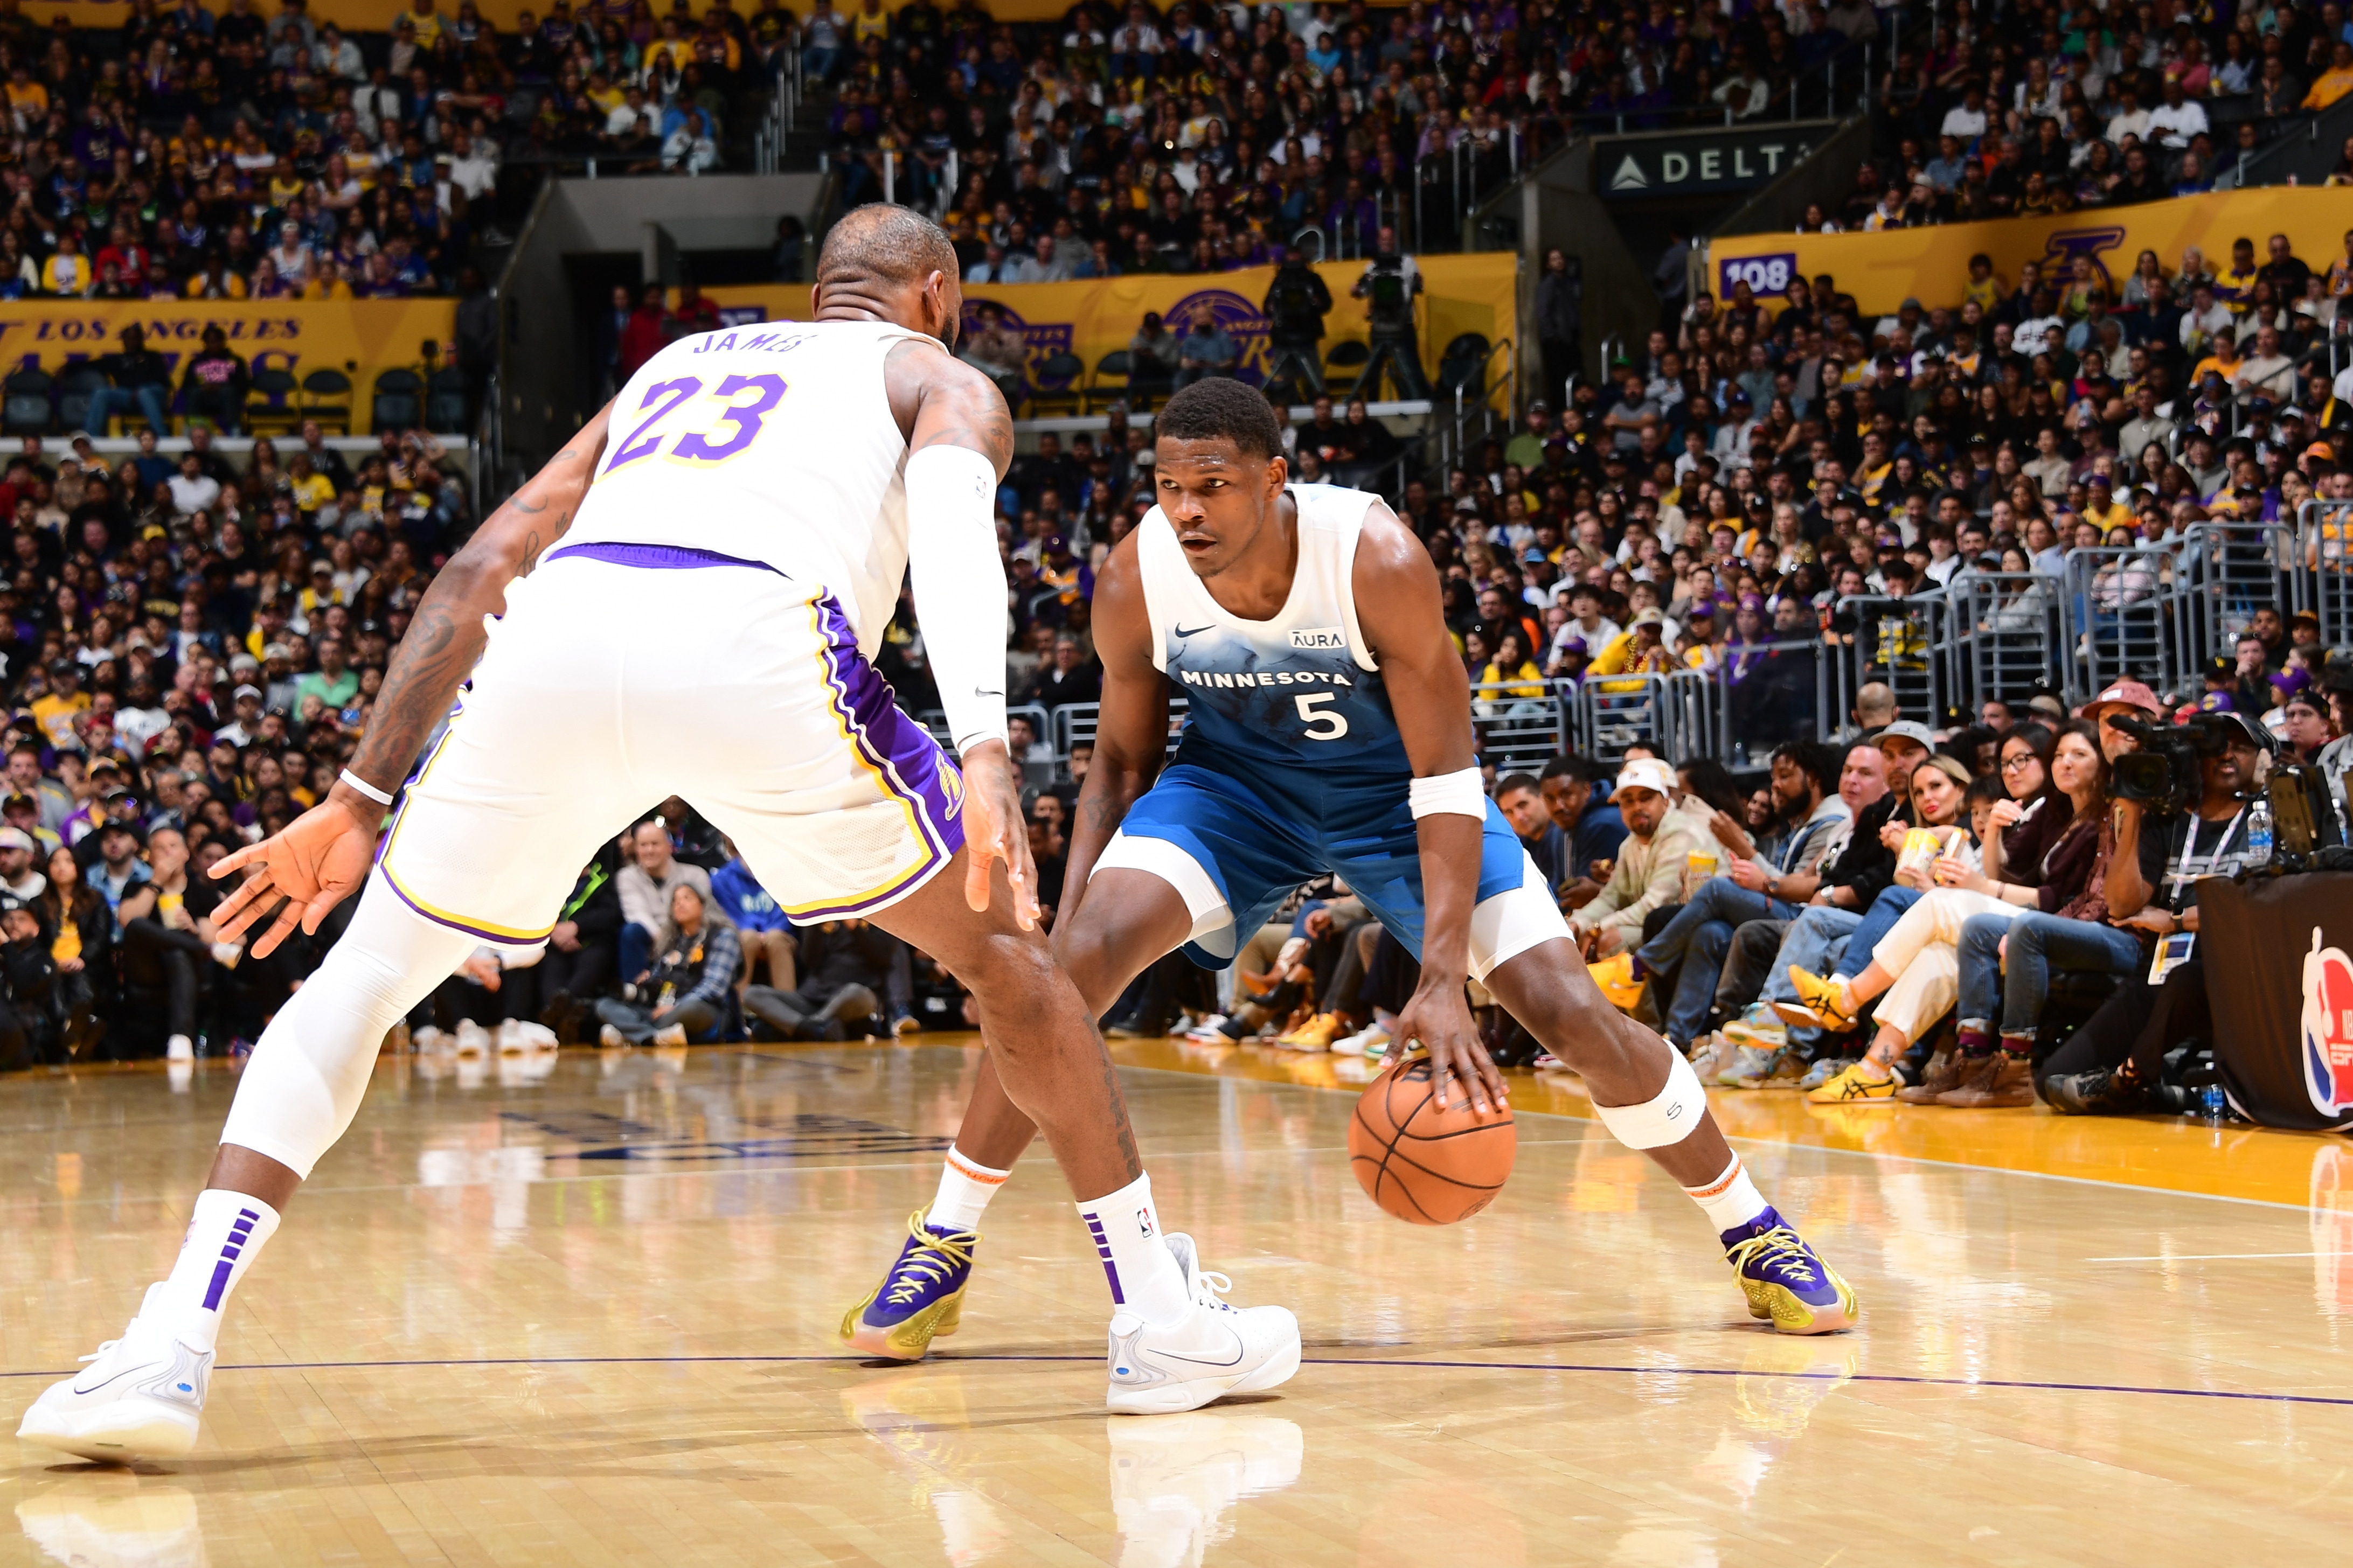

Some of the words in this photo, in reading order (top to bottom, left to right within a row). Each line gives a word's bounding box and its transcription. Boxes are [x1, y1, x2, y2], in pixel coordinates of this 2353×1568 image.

[1726, 259, 1789, 293] 108
[36, 320, 109, 340] LOS
[595, 372, 791, 480] 23
[1181, 670, 1353, 688] MINNESOTA
[1294, 692, 1348, 741] 5
